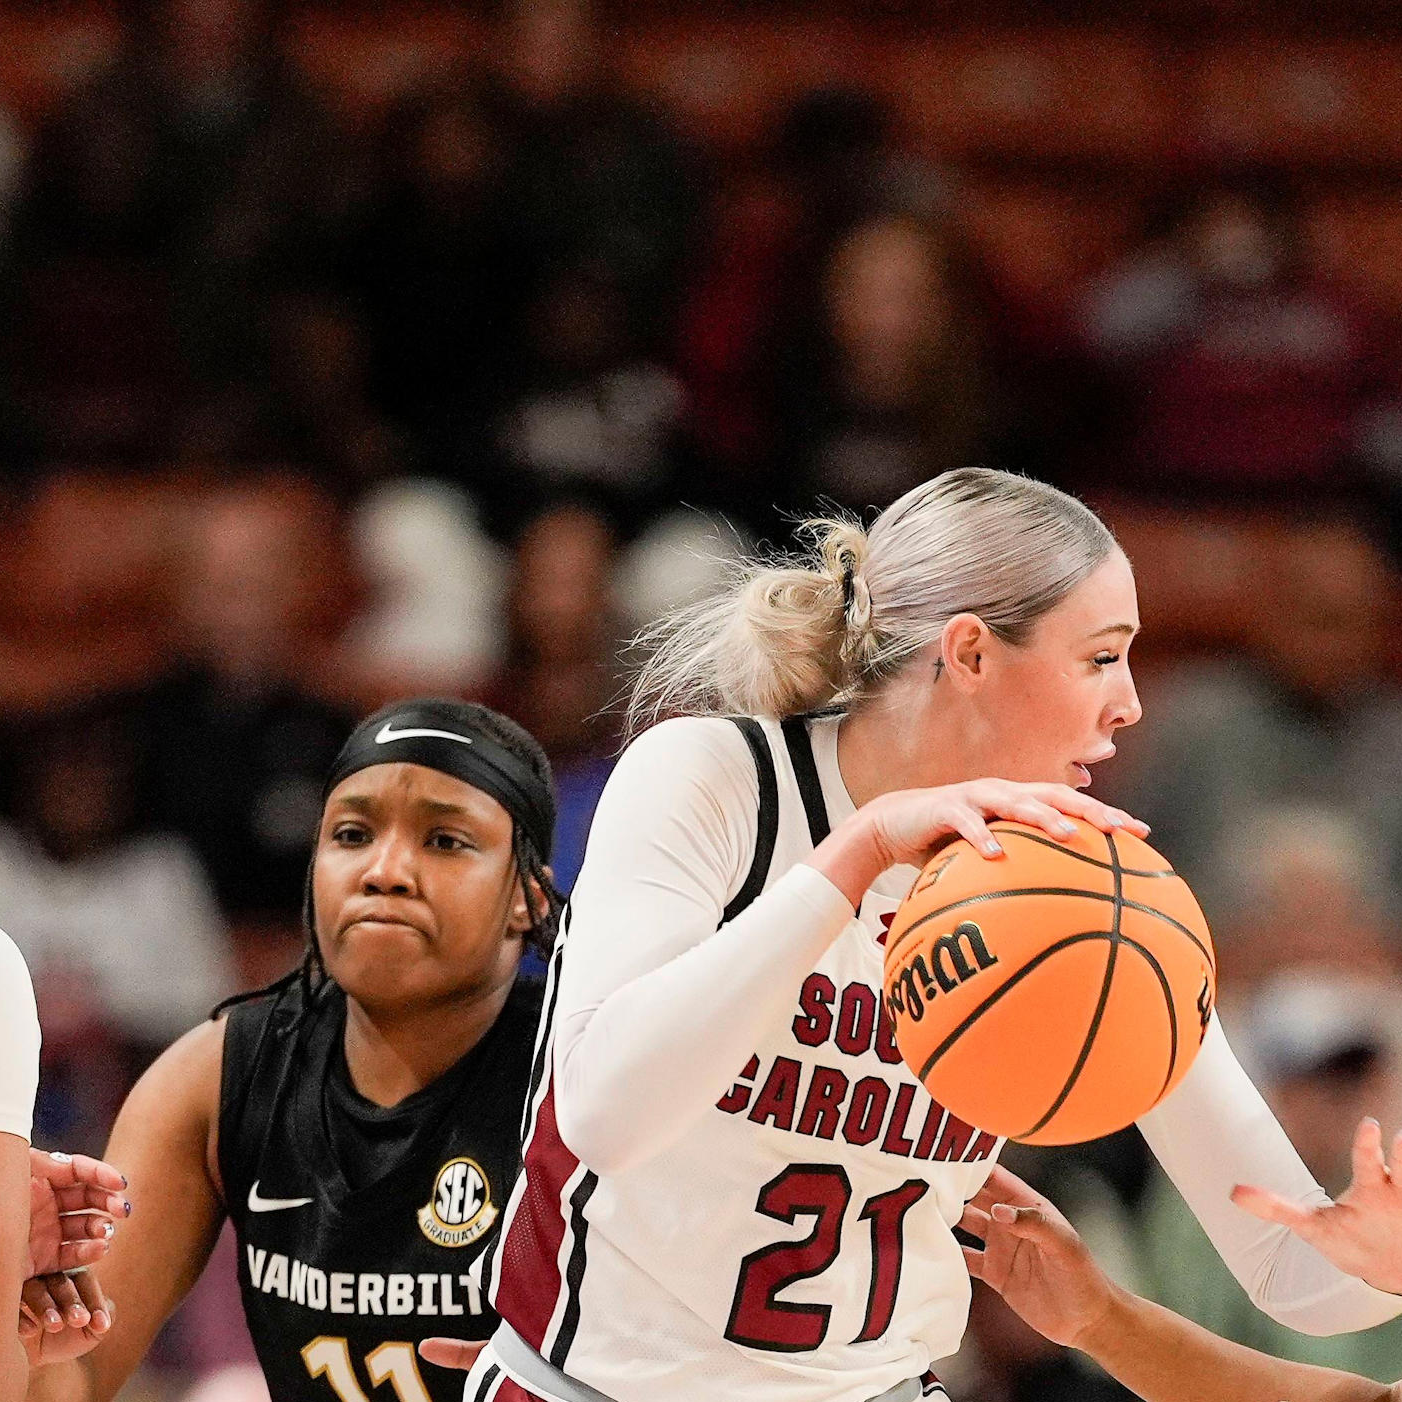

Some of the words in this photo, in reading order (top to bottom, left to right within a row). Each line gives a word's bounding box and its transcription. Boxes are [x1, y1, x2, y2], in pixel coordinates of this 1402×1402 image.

[435, 1162, 484, 1225] SEC
[423, 1219, 484, 1244] GRADUATE
[723, 1163, 930, 1353] 21
[247, 1243, 482, 1316] VANDERBILT
